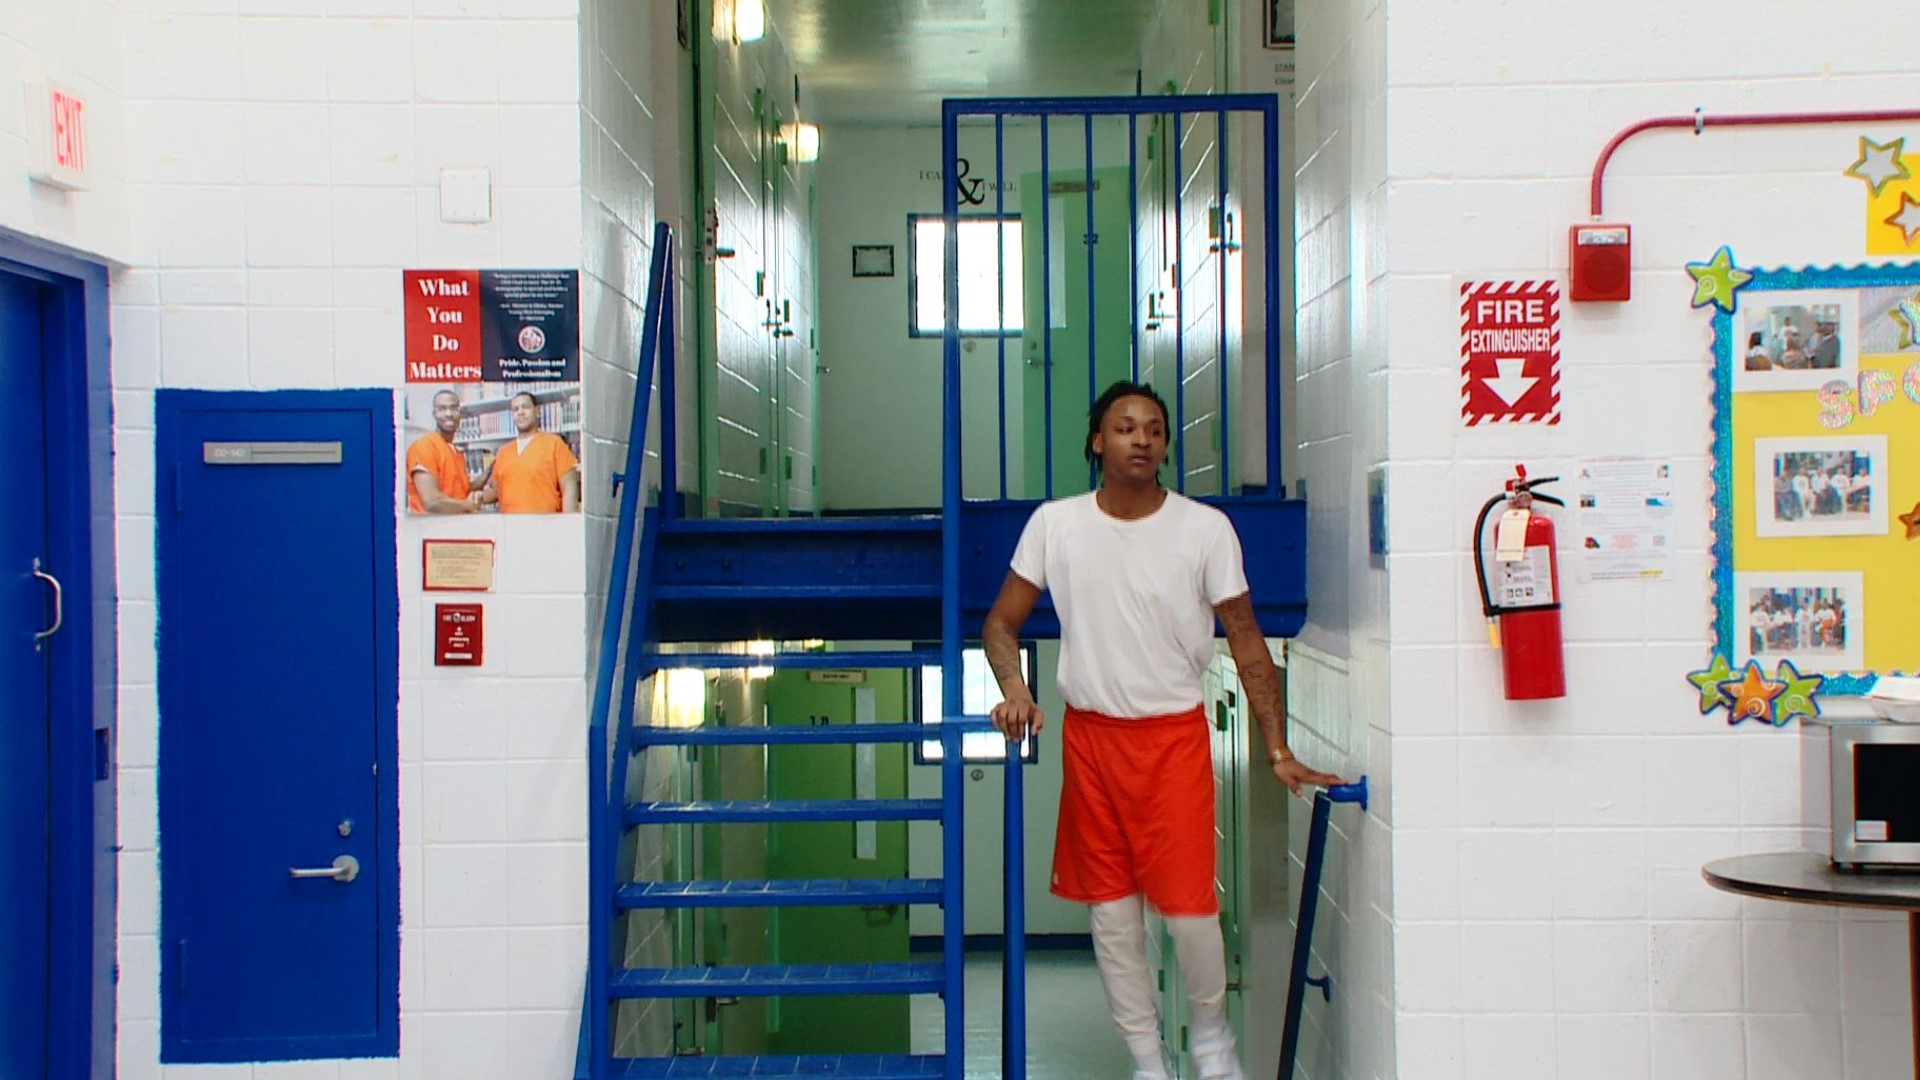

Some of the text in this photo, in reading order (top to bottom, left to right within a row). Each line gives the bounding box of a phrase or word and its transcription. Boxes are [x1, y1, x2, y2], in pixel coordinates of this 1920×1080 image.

[52, 90, 84, 173] EXIT
[926, 170, 944, 181] CA
[418, 278, 470, 297] What
[427, 307, 463, 324] You
[1477, 299, 1545, 324] FIRE
[432, 334, 460, 351] Do
[1470, 328, 1551, 353] EXTINGUISHER
[410, 362, 482, 379] Matters
